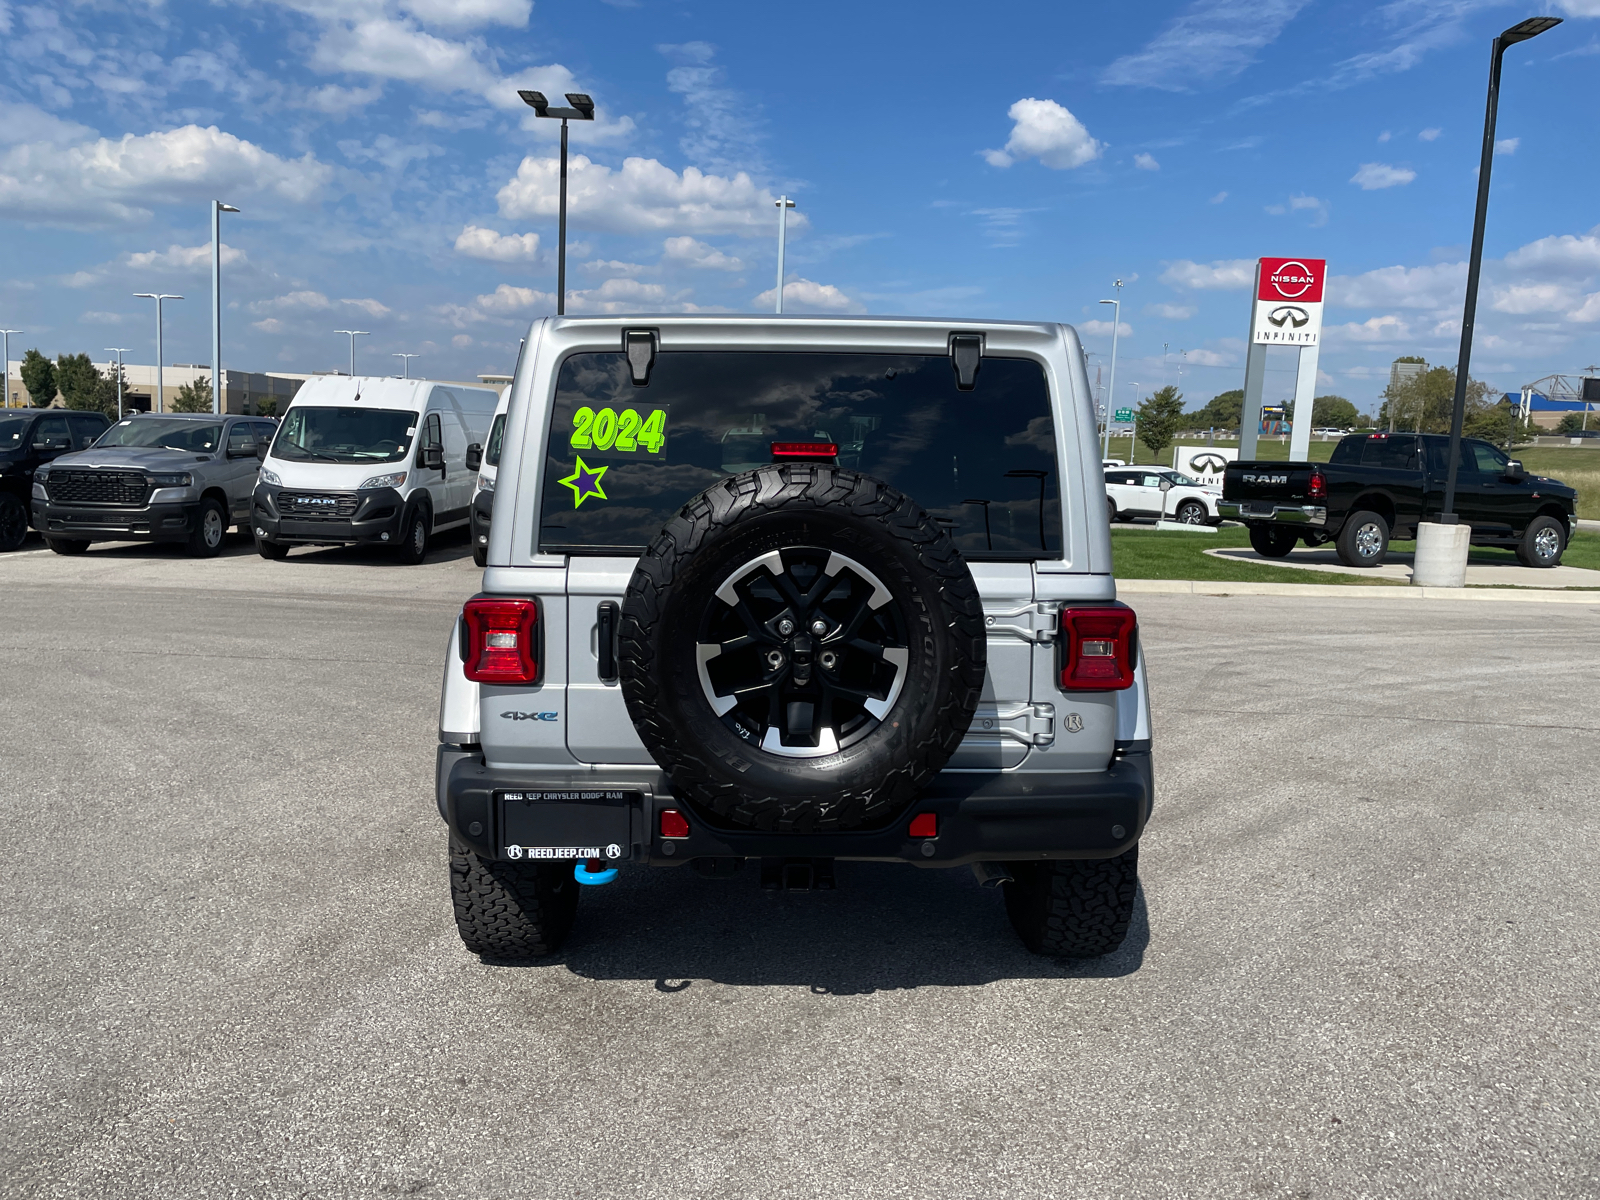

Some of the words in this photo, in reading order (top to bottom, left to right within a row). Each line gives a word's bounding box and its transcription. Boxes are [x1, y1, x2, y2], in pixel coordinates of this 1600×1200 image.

[1271, 275, 1314, 284] NISSAN
[1257, 331, 1317, 342] INFINITI
[570, 406, 667, 453] 2024
[1190, 477, 1224, 486] FINI
[1242, 474, 1289, 484] RAM
[297, 497, 337, 505] RAM
[504, 792, 523, 800] REED
[543, 792, 580, 800] CHRYSLER
[528, 848, 600, 859] REEDJEEP.COM
